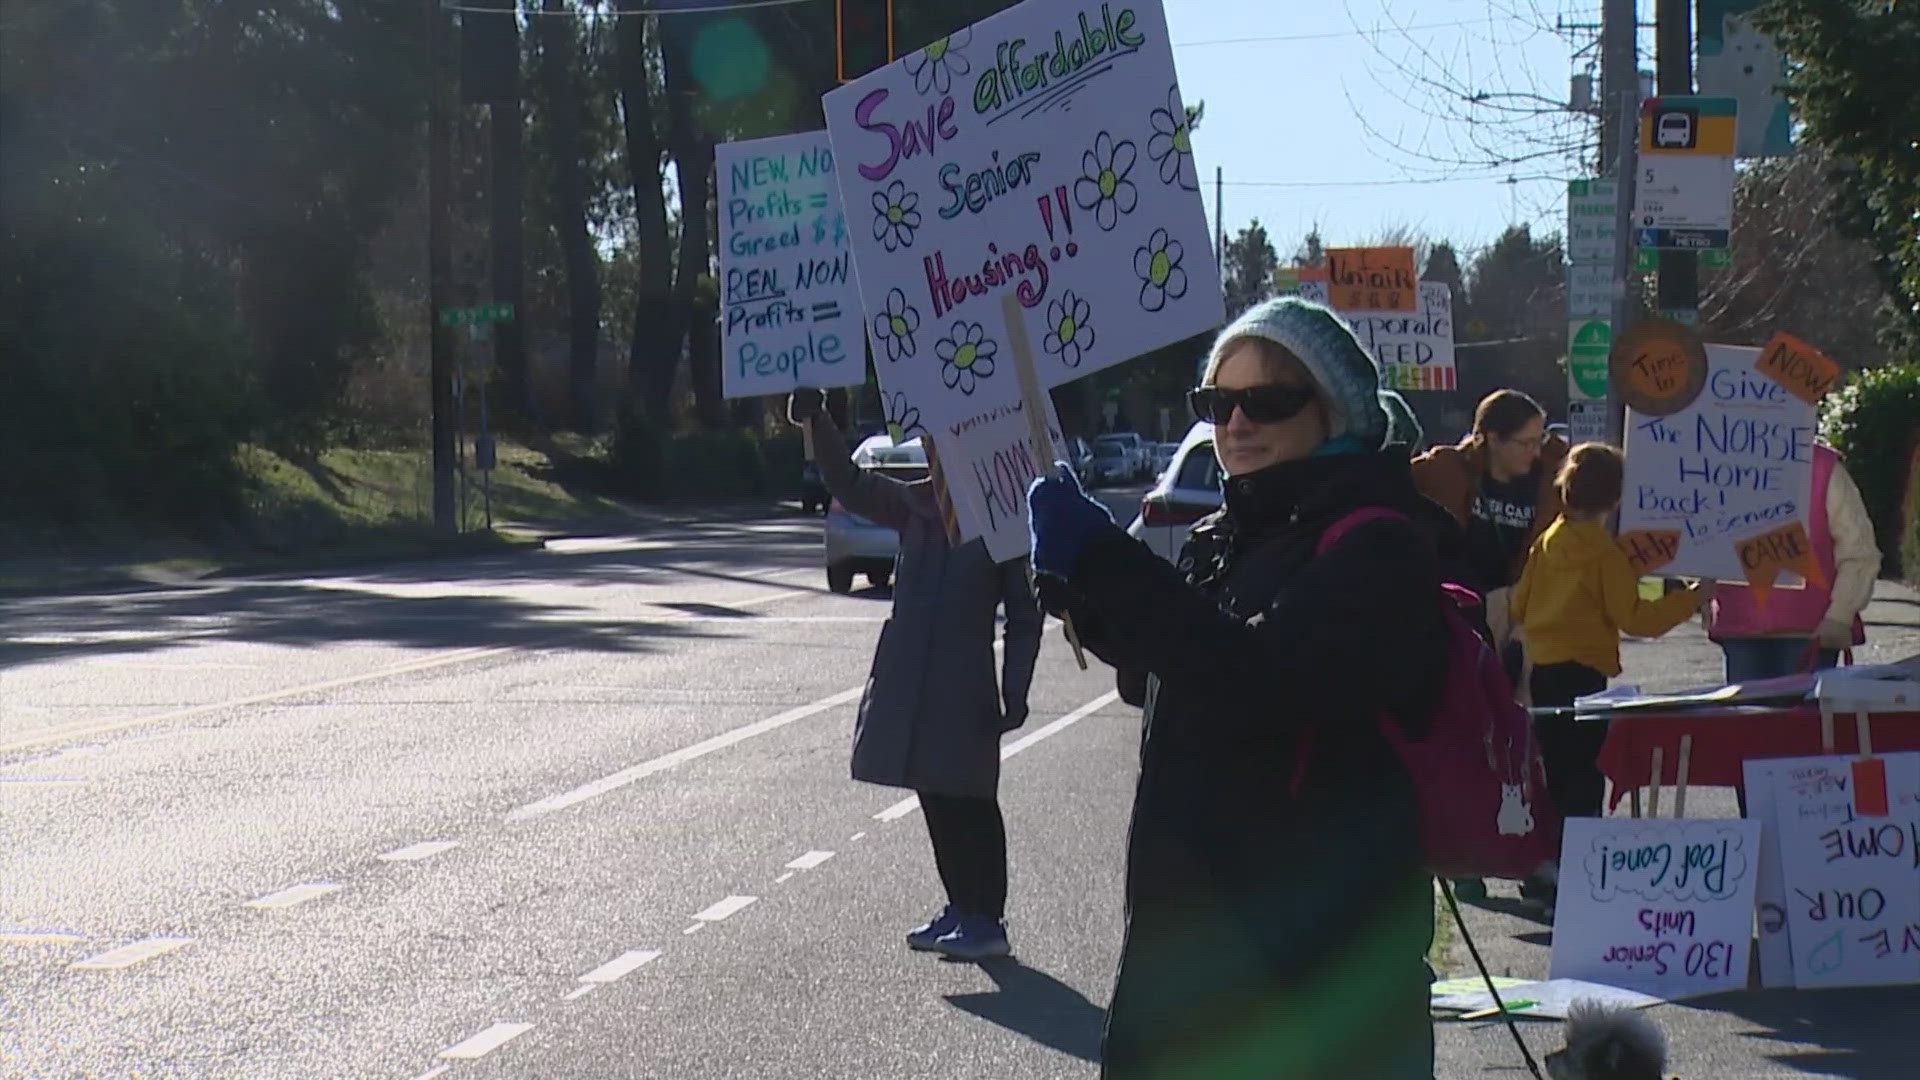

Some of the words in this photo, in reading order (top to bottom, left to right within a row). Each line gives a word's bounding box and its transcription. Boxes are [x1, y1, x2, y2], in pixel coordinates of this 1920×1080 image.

[855, 88, 957, 181] Save
[972, 4, 1145, 115] affordable
[798, 145, 836, 178] NO
[1645, 169, 1654, 184] 5
[938, 151, 1041, 219] Senior
[729, 192, 802, 229] Profits
[730, 224, 800, 256] Greed
[923, 186, 1078, 319] Housing!!
[796, 250, 848, 290] NON
[728, 300, 804, 336] Profits
[738, 331, 846, 380] People
[1375, 341, 1433, 366] EED
[1768, 342, 1832, 396] NOW
[1696, 413, 1811, 464] NORSE
[972, 439, 1038, 532] HOM
[1601, 843, 1672, 889] Gone!
[1675, 840, 1728, 893] Poof
[1639, 908, 1695, 938] Units
[1795, 887, 1886, 922] OUR
[1603, 942, 1676, 976] Senior
[1686, 940, 1733, 977] 130
[1859, 922, 1920, 960] VE
